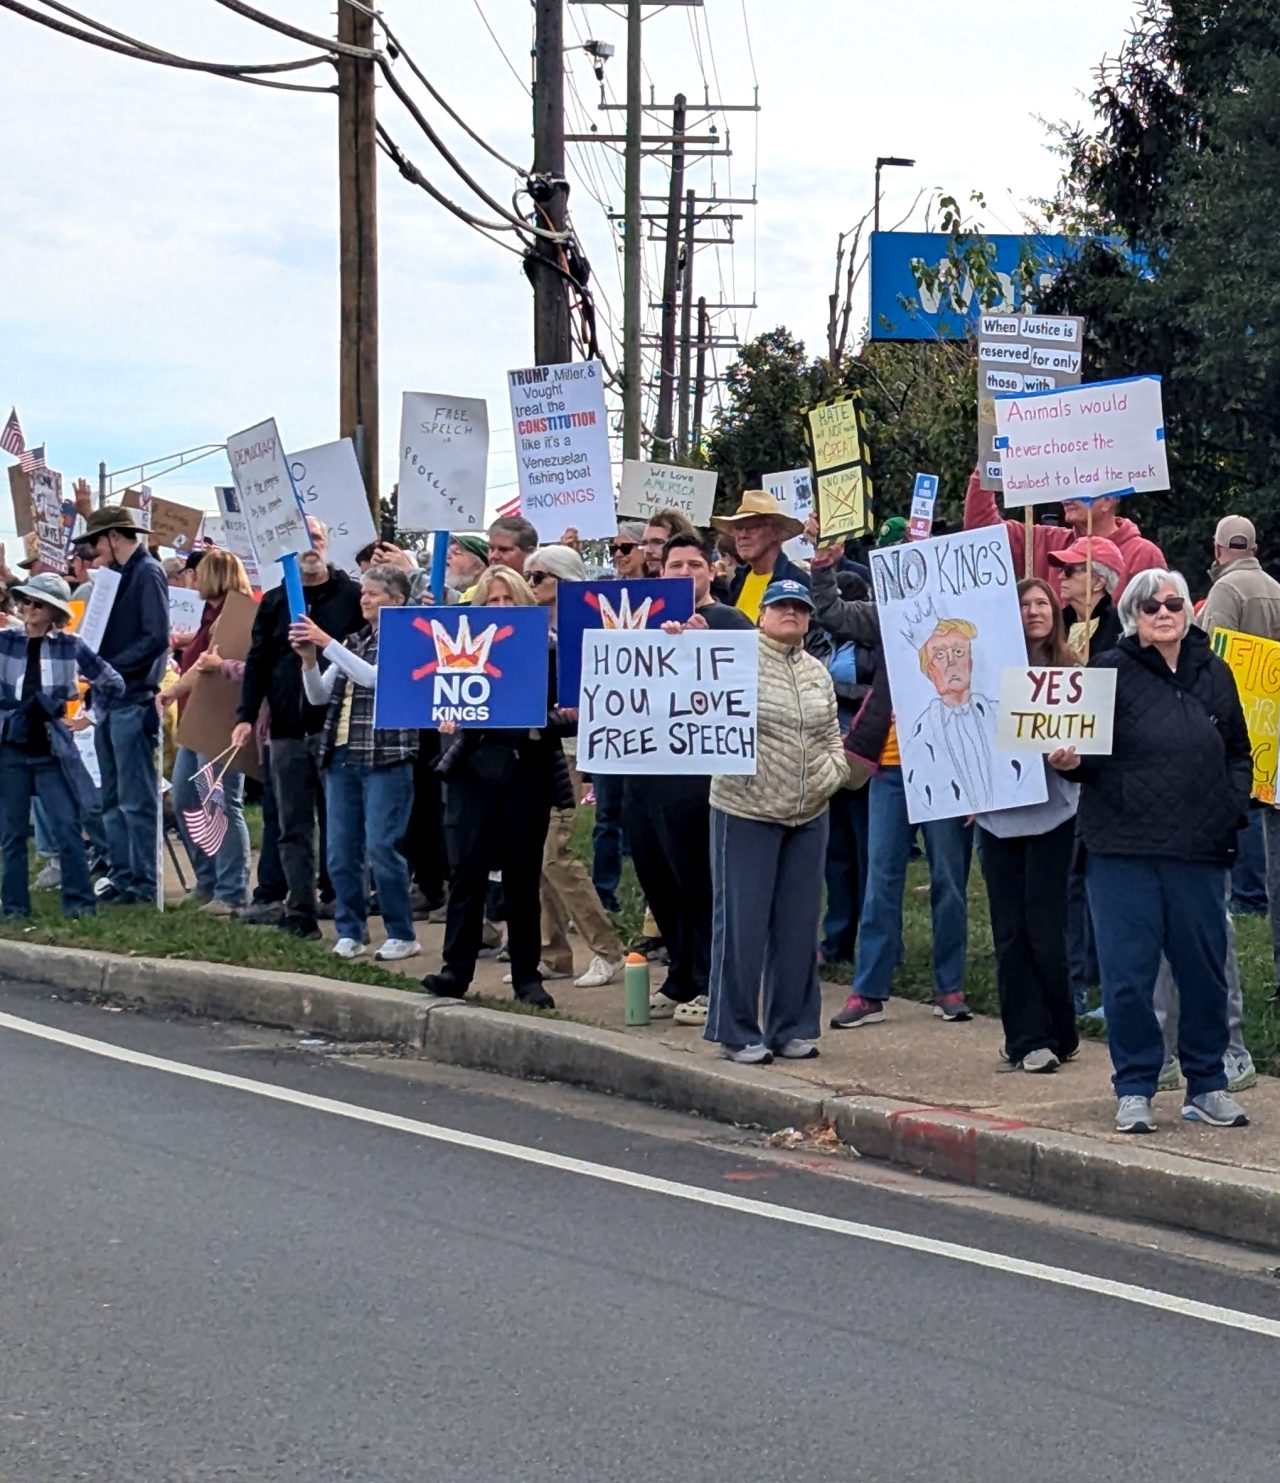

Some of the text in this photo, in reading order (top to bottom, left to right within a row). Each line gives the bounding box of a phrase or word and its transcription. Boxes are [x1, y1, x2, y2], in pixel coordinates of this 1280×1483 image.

[984, 320, 1073, 337] When Justice is
[980, 345, 1079, 372] reserved for only
[587, 365, 596, 377] &
[523, 384, 563, 399] Vought
[987, 375, 1050, 391] those with
[435, 407, 469, 421] FREE
[515, 401, 566, 418] treat the
[818, 404, 849, 424] HATE
[1007, 393, 1128, 422] Animals would
[517, 411, 596, 435] CONSTITUTION
[521, 435, 571, 450] like it's a
[1006, 442, 1041, 458] never
[1044, 436, 1089, 455] choose
[1092, 432, 1114, 449] the
[522, 452, 588, 469] Venezuelan
[528, 465, 591, 485] fishing boat
[1007, 464, 1156, 490] dumbest to lead the pack
[643, 479, 696, 495] AMERICA
[527, 488, 595, 509] #NOKINGS
[666, 497, 693, 511] HATE
[872, 540, 1008, 606] NO KINGS
[593, 644, 735, 681] HONK IF
[432, 675, 491, 706] NO
[1027, 670, 1082, 705] YES
[583, 685, 751, 721] YOU LOVE
[431, 705, 489, 722] KINGS
[1010, 711, 1096, 741] TRUTH
[588, 722, 755, 760] FREE SPEECH
